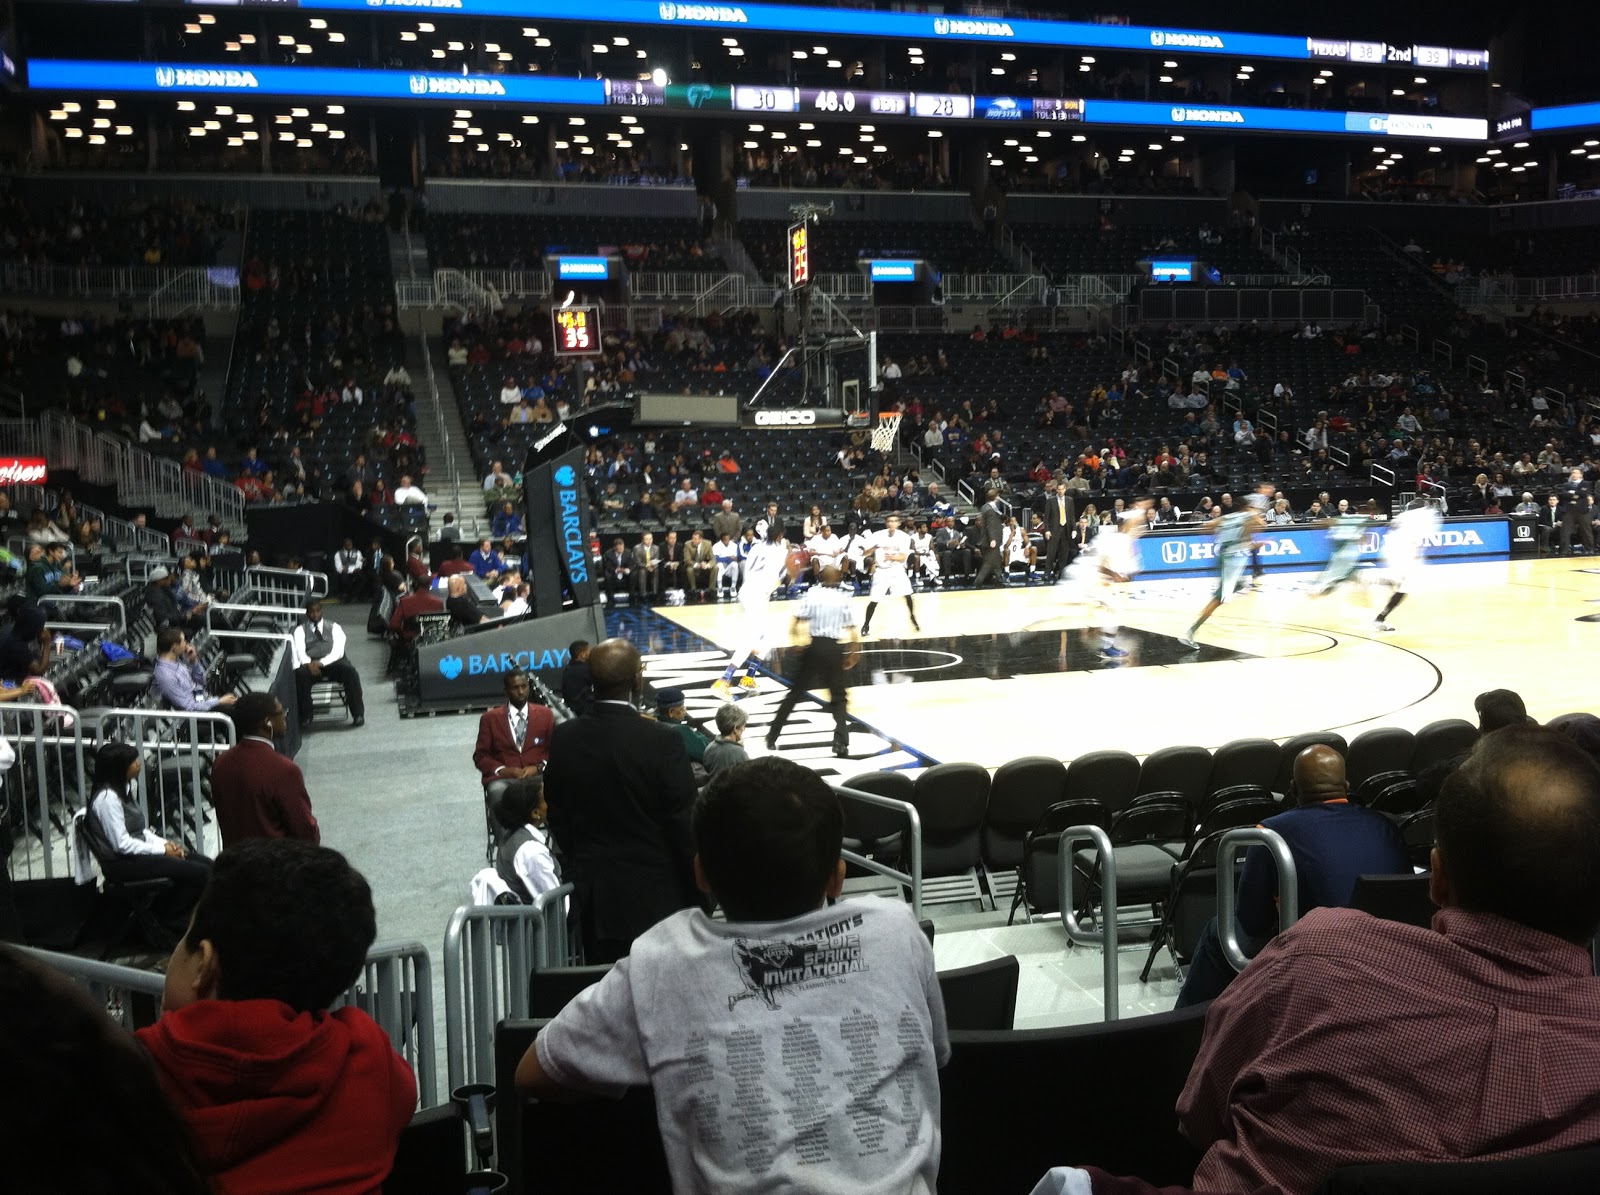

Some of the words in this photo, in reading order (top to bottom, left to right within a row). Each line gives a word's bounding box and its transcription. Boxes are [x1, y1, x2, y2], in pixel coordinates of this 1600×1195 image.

[677, 4, 748, 23] HONDA
[949, 20, 1015, 37] HONDA
[1164, 32, 1225, 49] HONDA
[1312, 42, 1347, 57] TEXAS
[1359, 45, 1373, 59] 38
[1387, 45, 1412, 62] 2nd
[1426, 49, 1440, 64] 39
[175, 68, 259, 88] HONDA
[428, 76, 506, 96] HONDA
[753, 89, 776, 110] 30
[931, 98, 954, 117] 28
[1185, 109, 1245, 123] HONDA
[566, 327, 589, 348] 35
[754, 410, 816, 426] GEICO
[559, 489, 589, 585] BARCLAYS
[1189, 538, 1301, 560] HDA
[467, 647, 572, 675] BARCLAY
[817, 933, 861, 950] 2012
[803, 947, 862, 967] SPRING
[763, 958, 870, 986] INVITATIONAL
